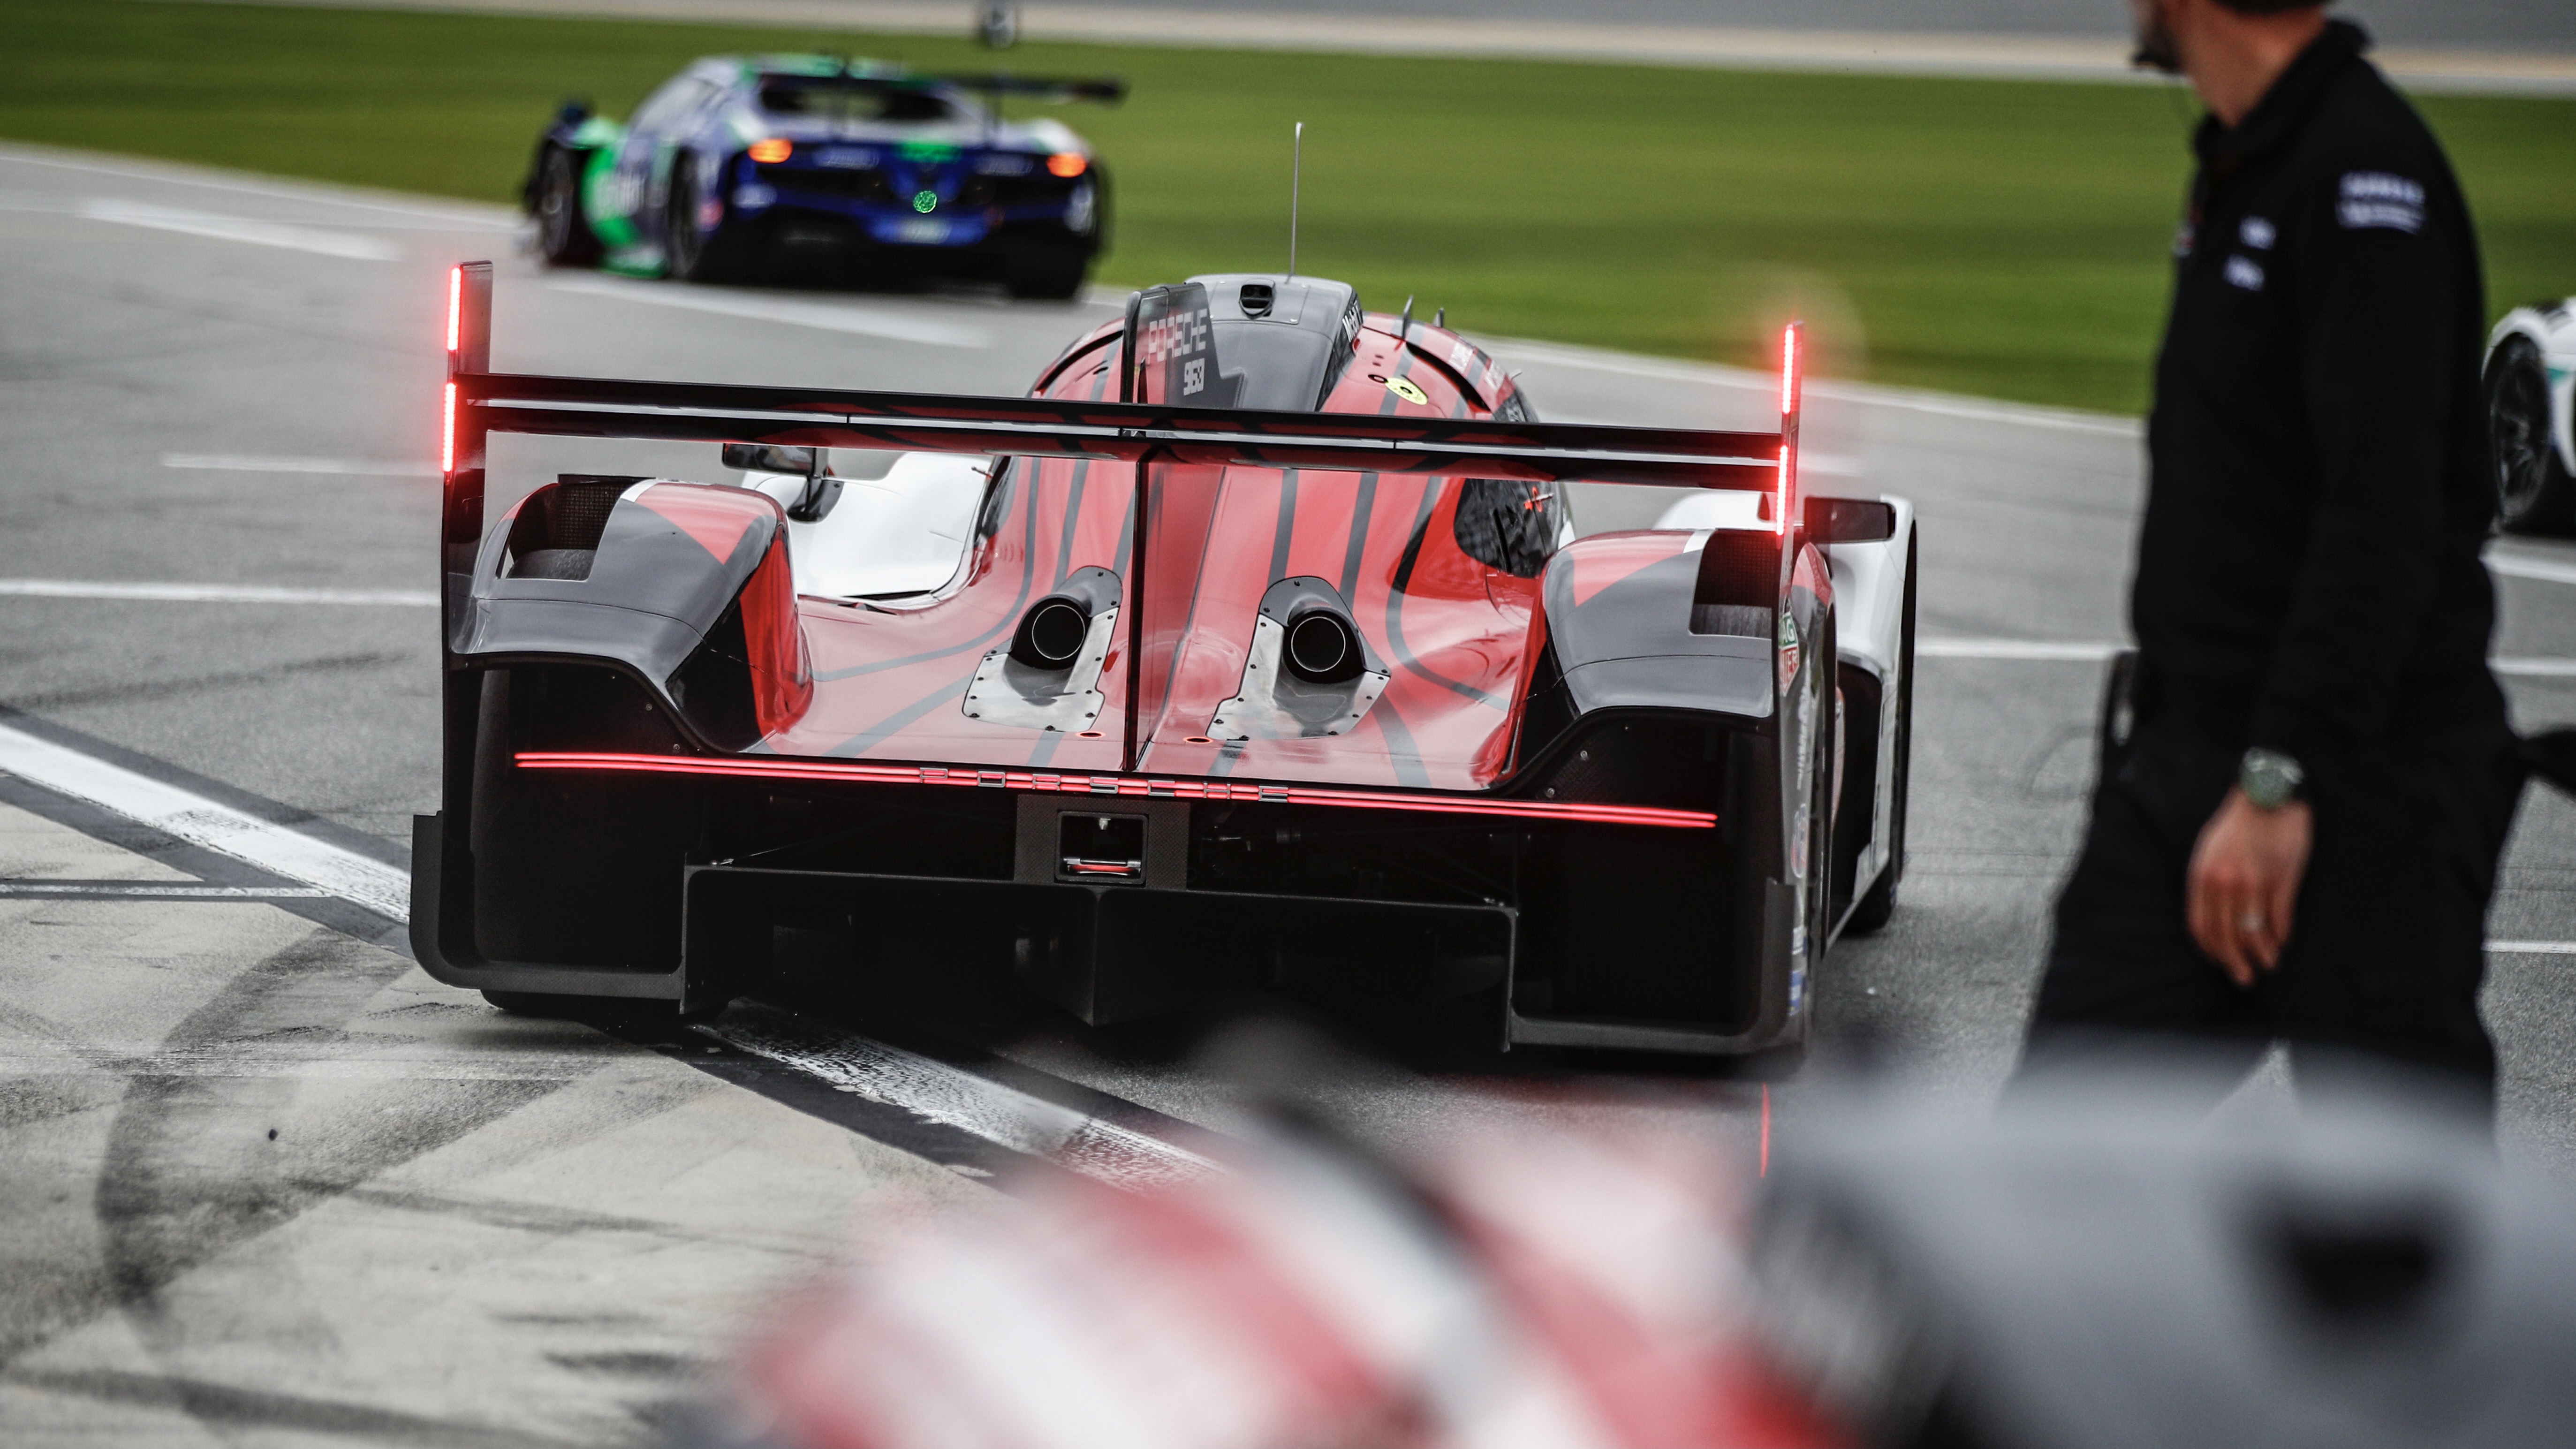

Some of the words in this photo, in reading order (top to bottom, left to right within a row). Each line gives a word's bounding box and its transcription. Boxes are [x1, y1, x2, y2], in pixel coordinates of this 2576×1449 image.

[1148, 308, 1208, 365] PORSCHE
[1183, 357, 1205, 396] 963
[920, 767, 1288, 803] PORSCHE
